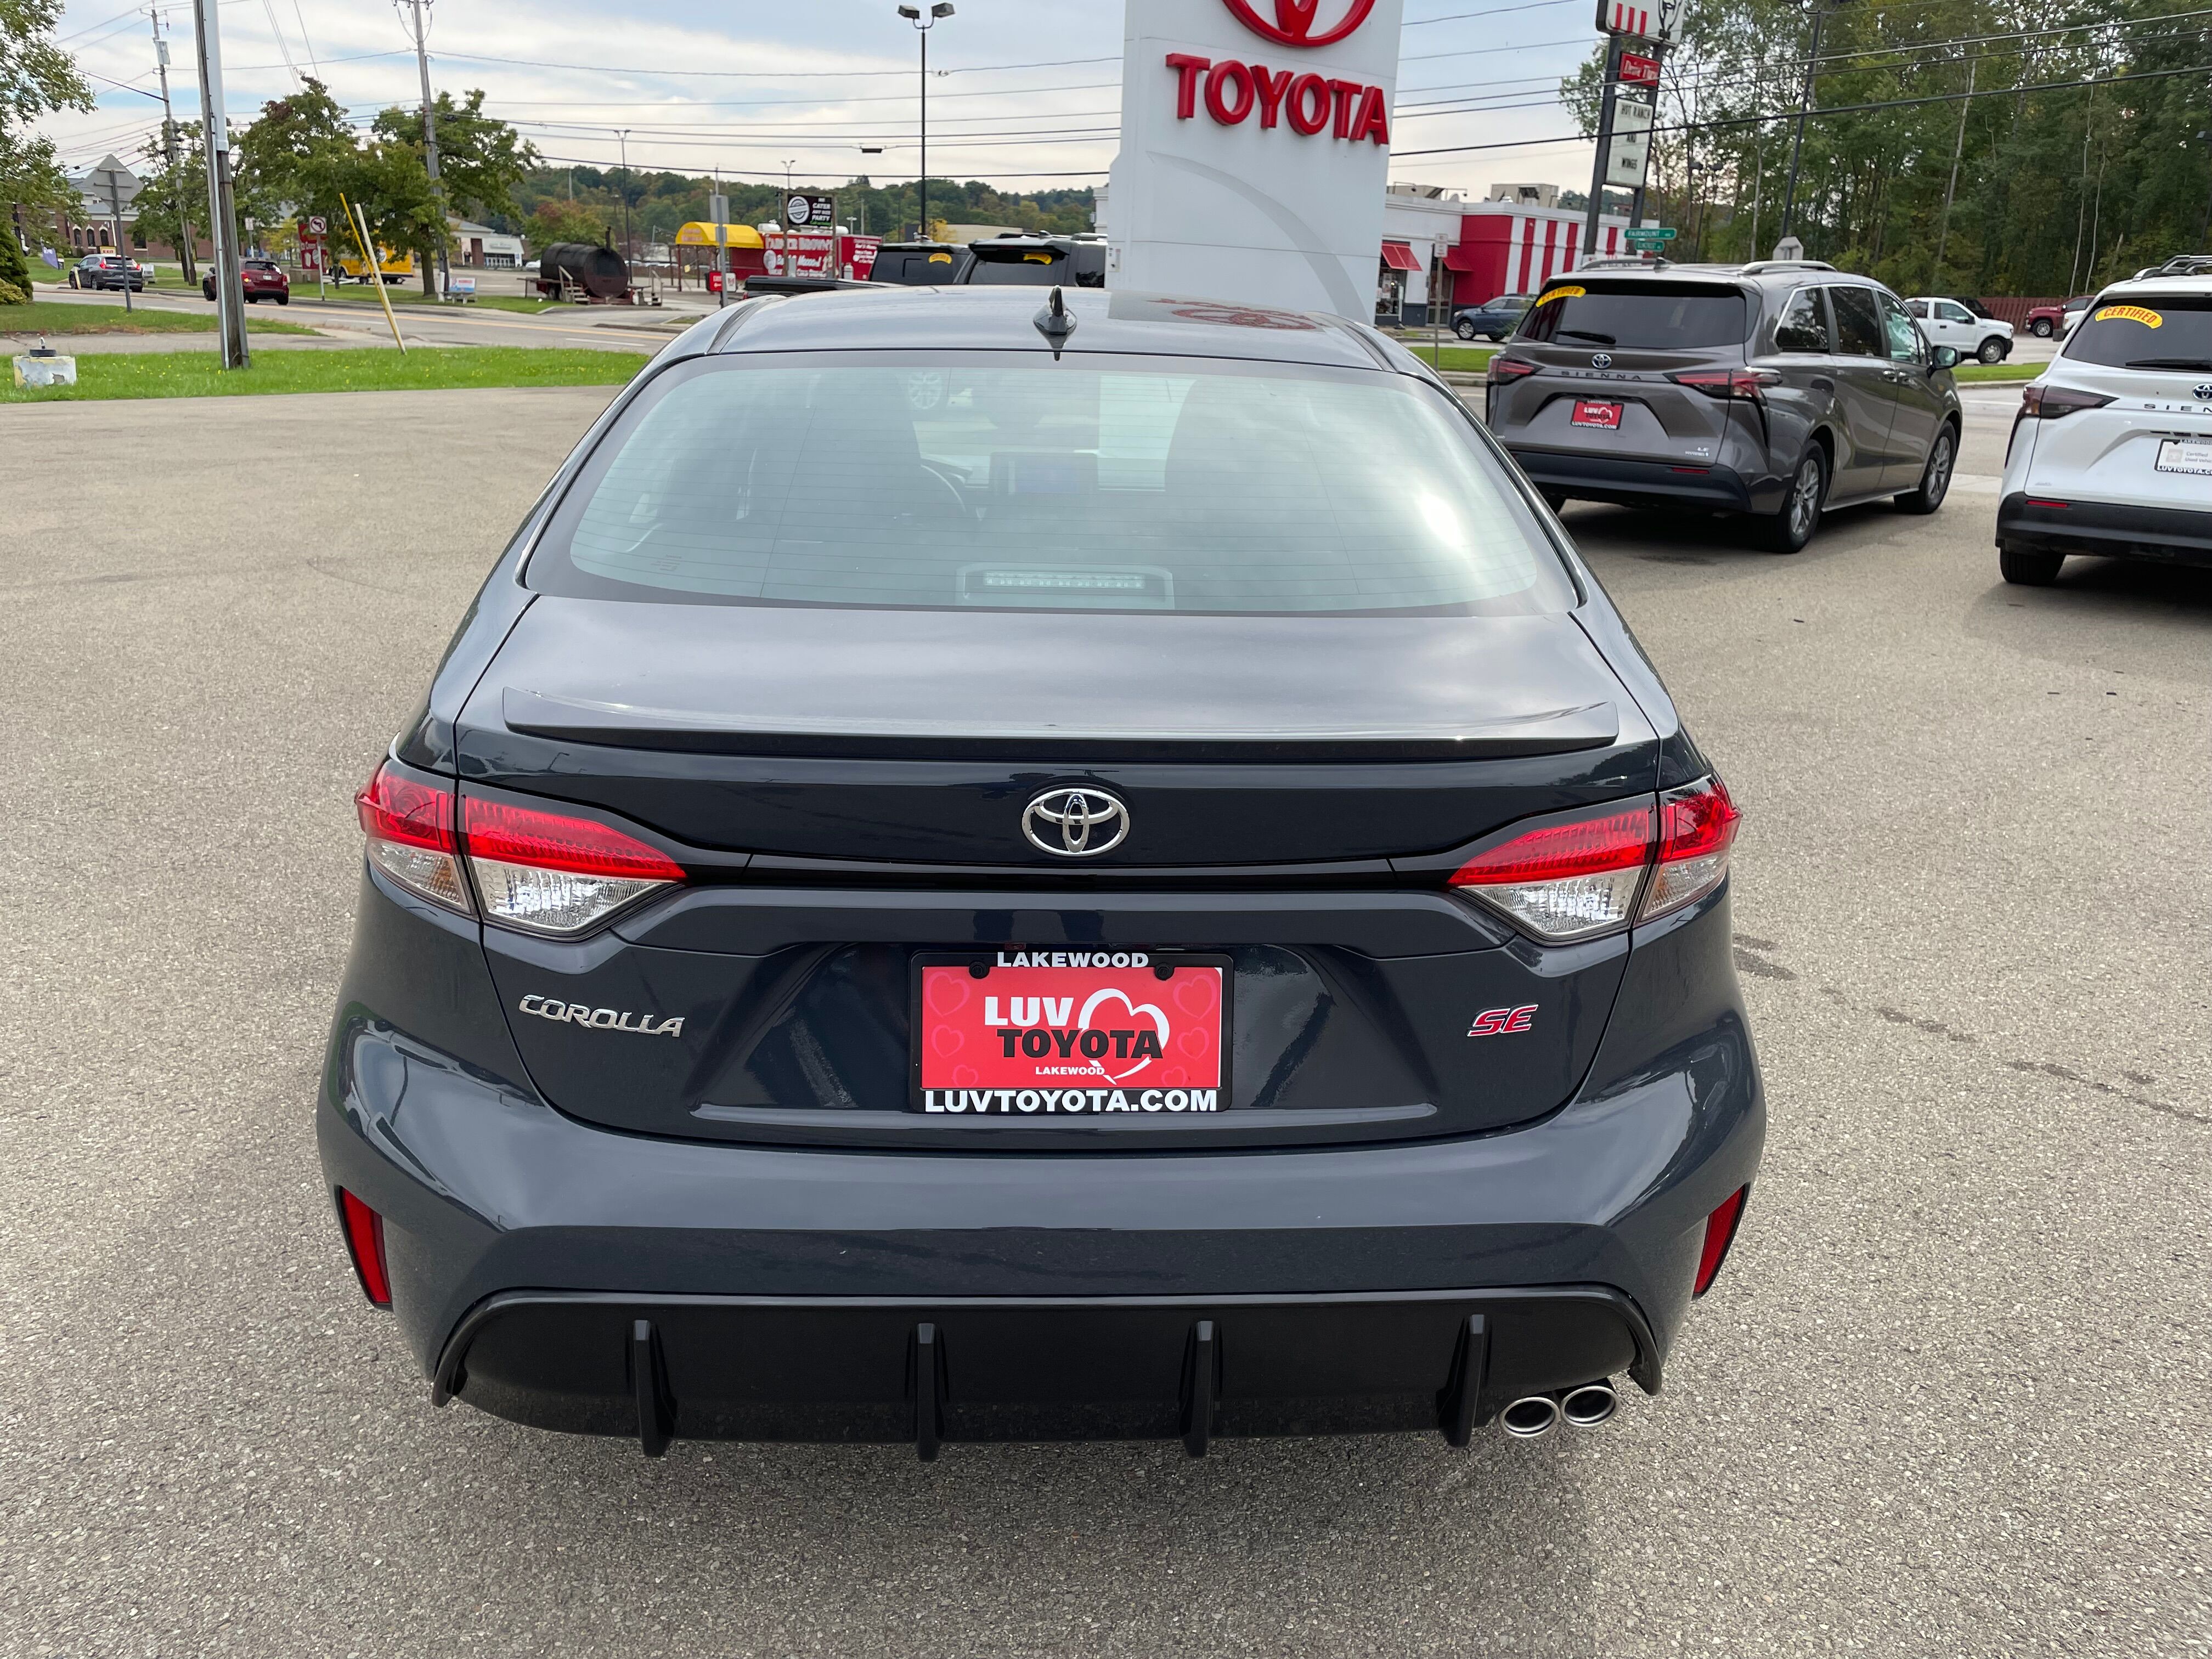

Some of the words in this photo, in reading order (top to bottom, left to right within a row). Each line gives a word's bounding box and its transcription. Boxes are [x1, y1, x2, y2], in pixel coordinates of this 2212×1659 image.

[1166, 53, 1389, 145] TOYOTA
[2104, 307, 2158, 324] CERTIFIED
[1561, 371, 1642, 381] SIENNA
[997, 951, 1149, 968] LAKEWOOD
[518, 994, 685, 1038] COROLLA
[984, 996, 1074, 1026] LUV
[1467, 1004, 1539, 1037] SE
[996, 1029, 1163, 1059] TOYOTA
[1035, 1066, 1105, 1075] LAKEWOOD
[924, 1089, 1217, 1113] LUVTOYOTA.COM
